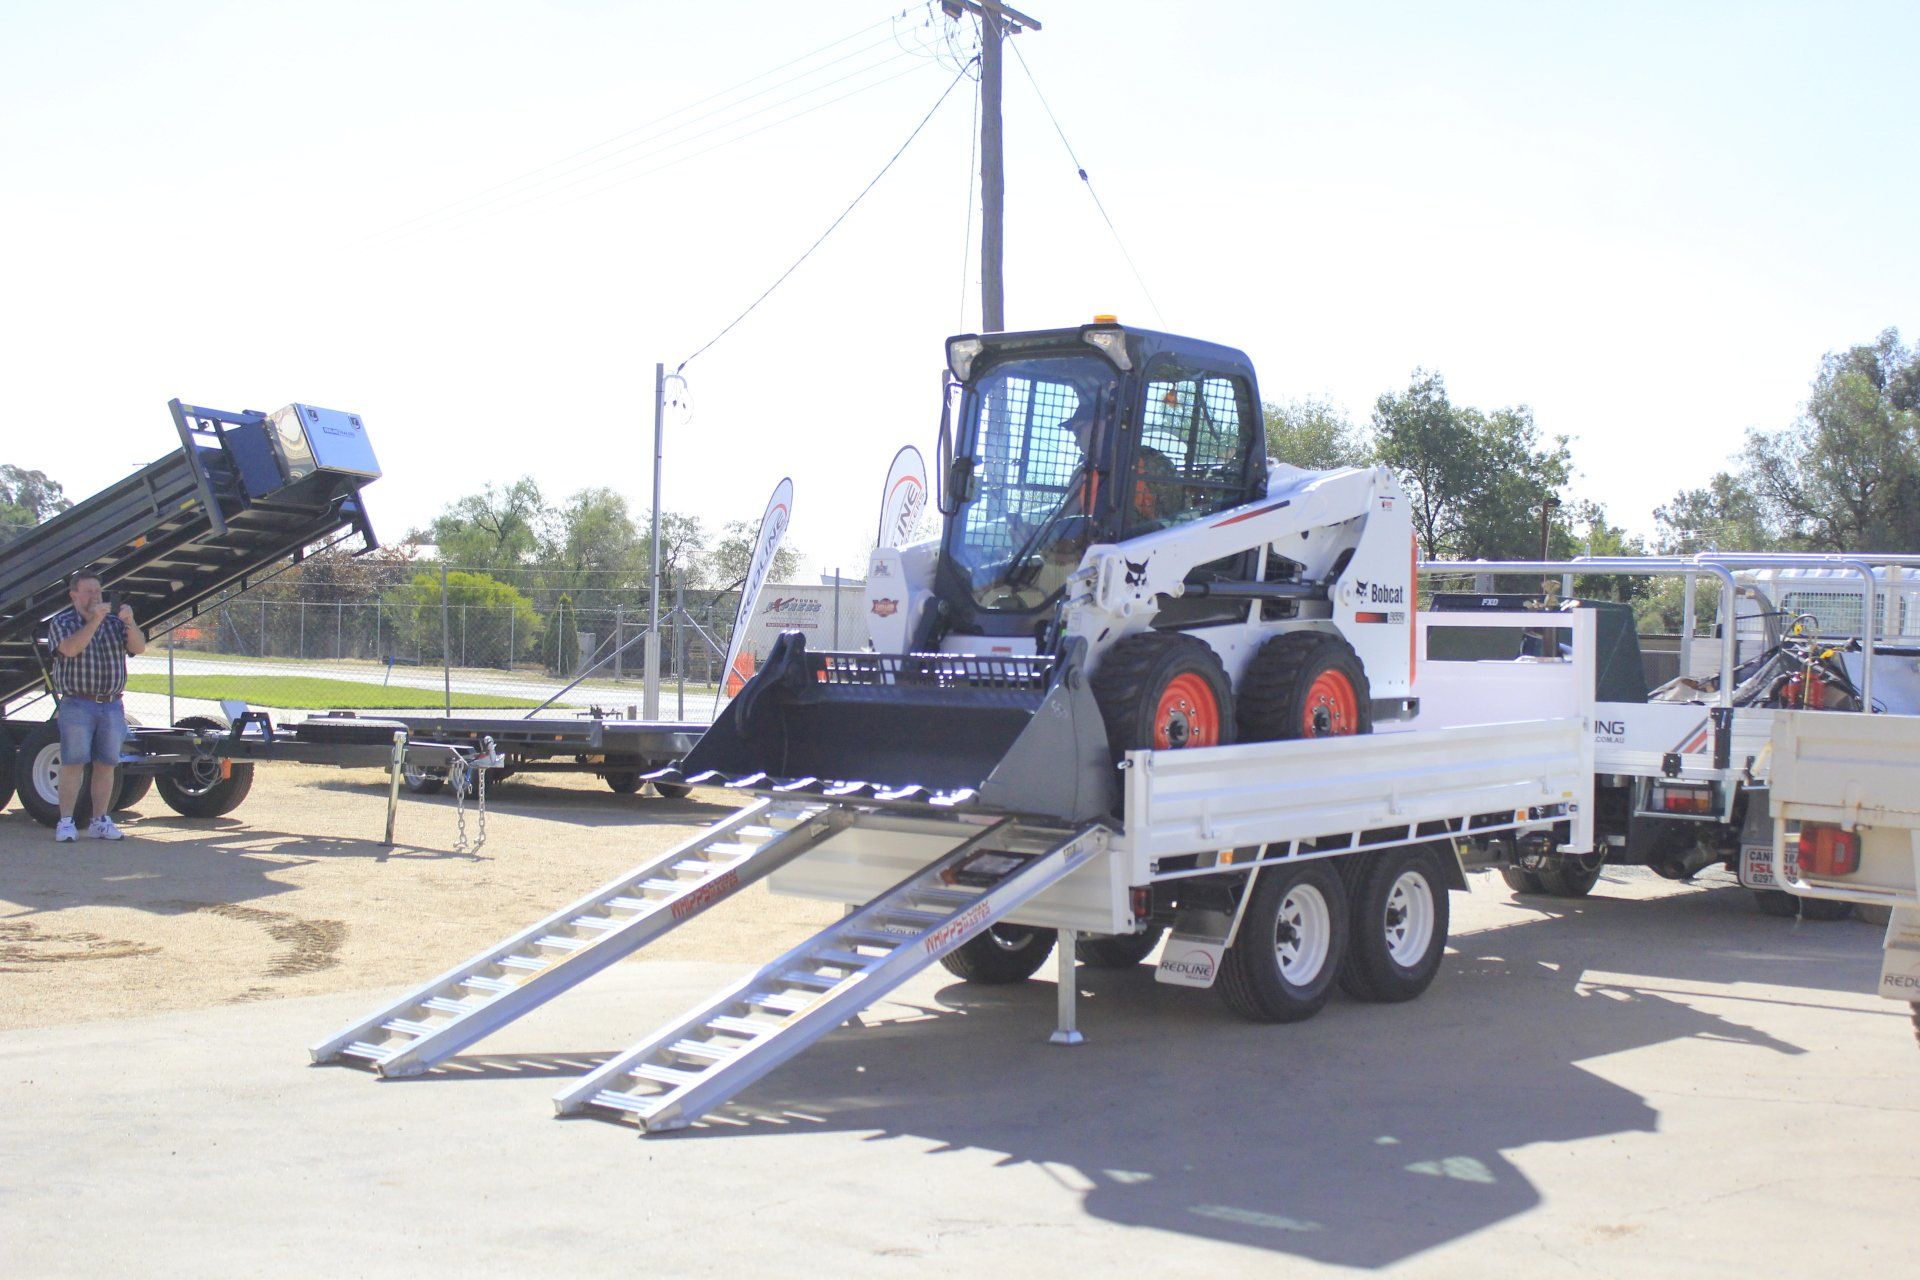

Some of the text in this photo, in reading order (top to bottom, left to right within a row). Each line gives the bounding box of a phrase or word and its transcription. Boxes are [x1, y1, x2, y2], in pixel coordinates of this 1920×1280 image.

[1371, 583, 1403, 604] Bobcat
[1481, 598, 1499, 606] FXD
[1160, 961, 1212, 976] REDLINE
